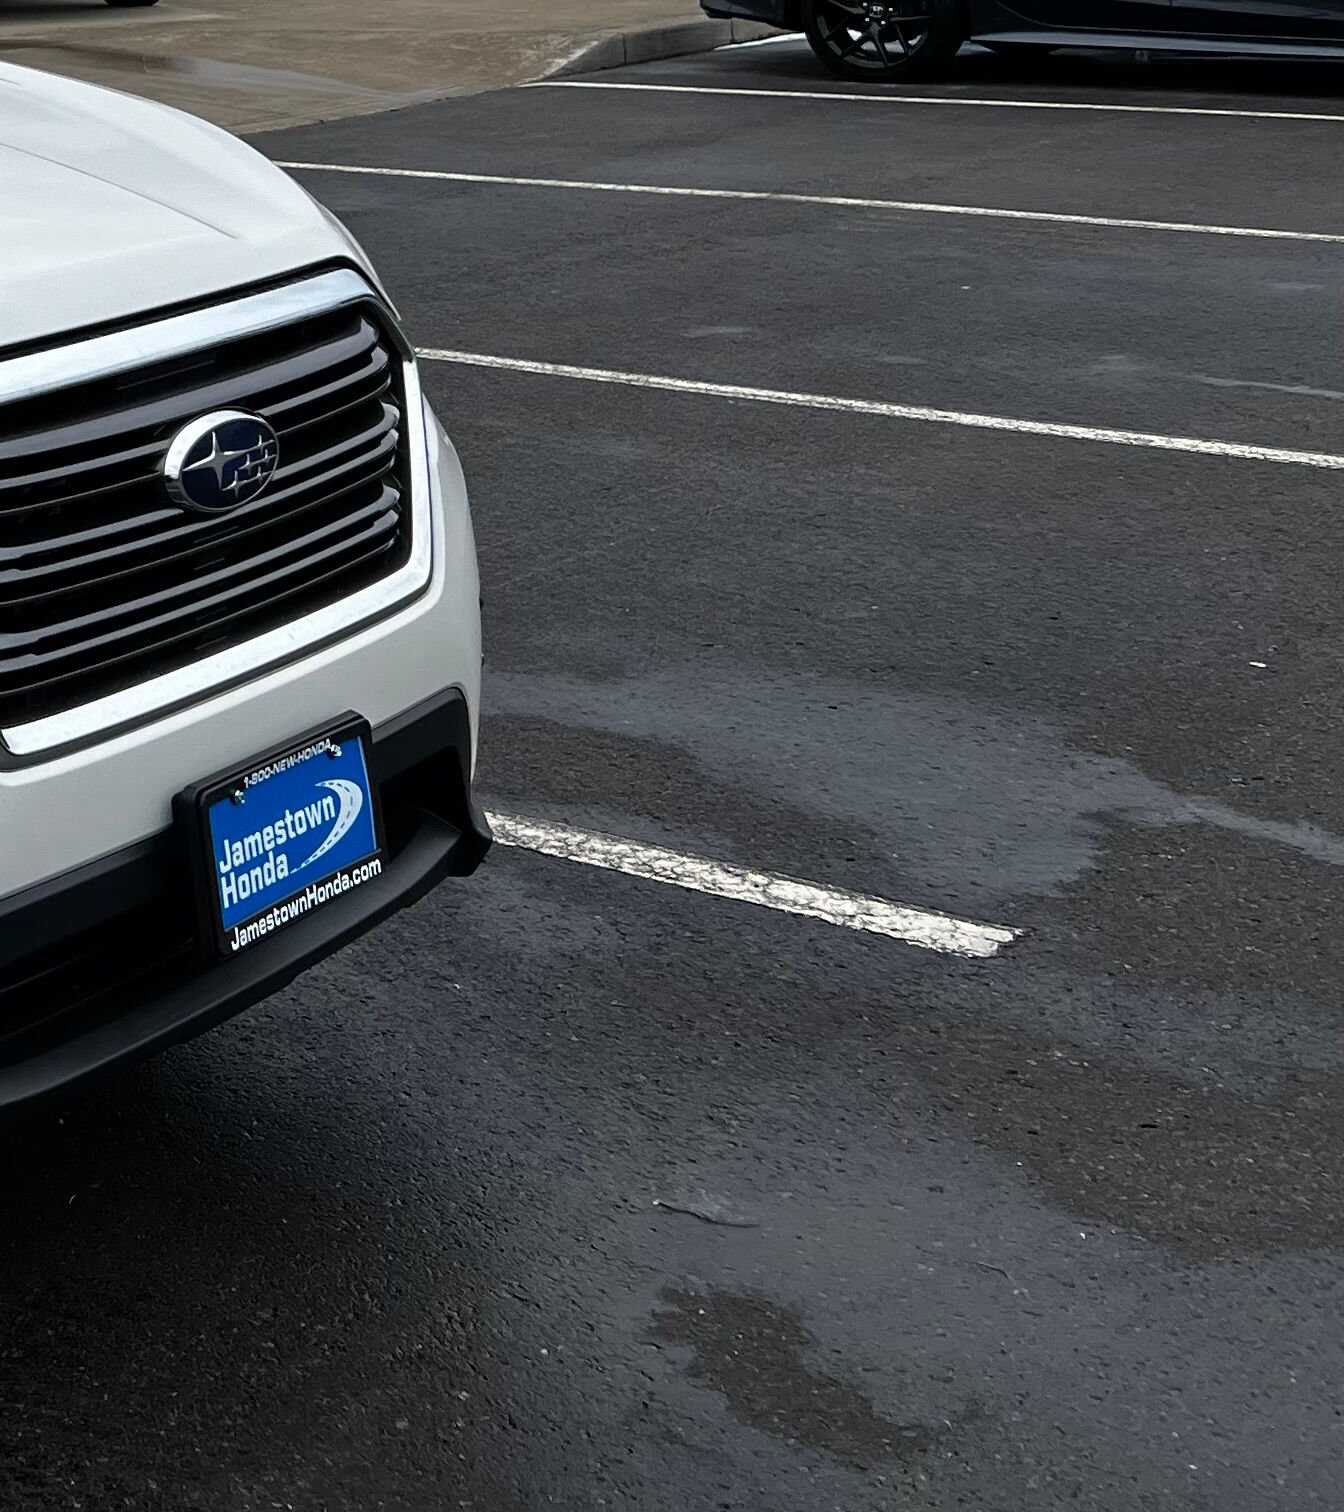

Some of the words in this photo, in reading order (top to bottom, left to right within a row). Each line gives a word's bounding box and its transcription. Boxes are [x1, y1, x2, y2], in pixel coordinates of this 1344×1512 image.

[219, 795, 336, 874] Jamestown
[220, 851, 289, 909] Honda
[231, 859, 382, 951] JamestownHonda.com
